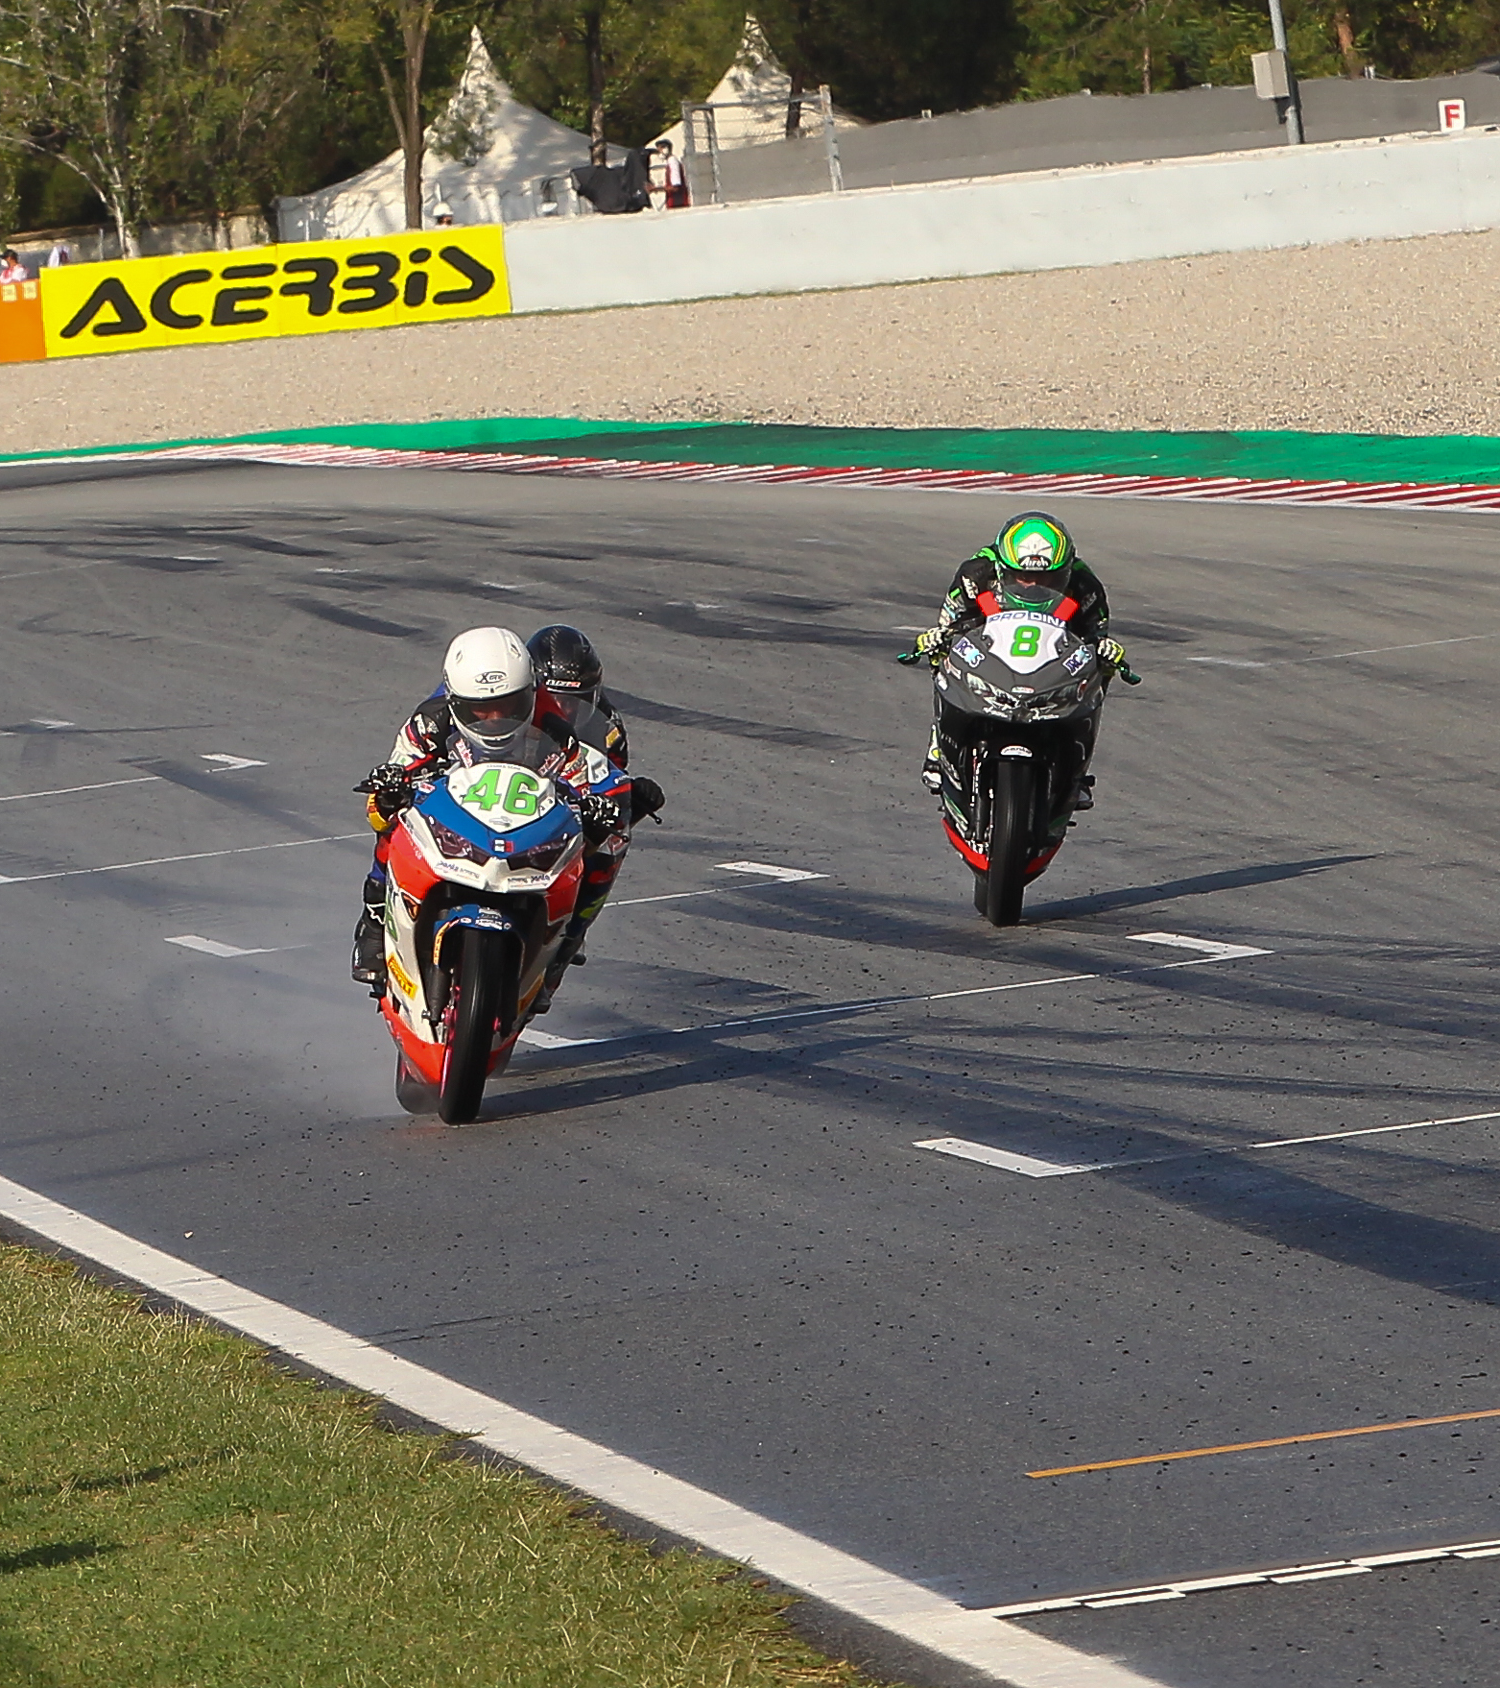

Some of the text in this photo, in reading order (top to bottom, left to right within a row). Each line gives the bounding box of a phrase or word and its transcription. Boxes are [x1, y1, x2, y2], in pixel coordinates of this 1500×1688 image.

[1444, 104, 1460, 128] F
[1019, 556, 1049, 567] Airoh
[1010, 625, 1041, 658] 8
[463, 768, 539, 817] 46
